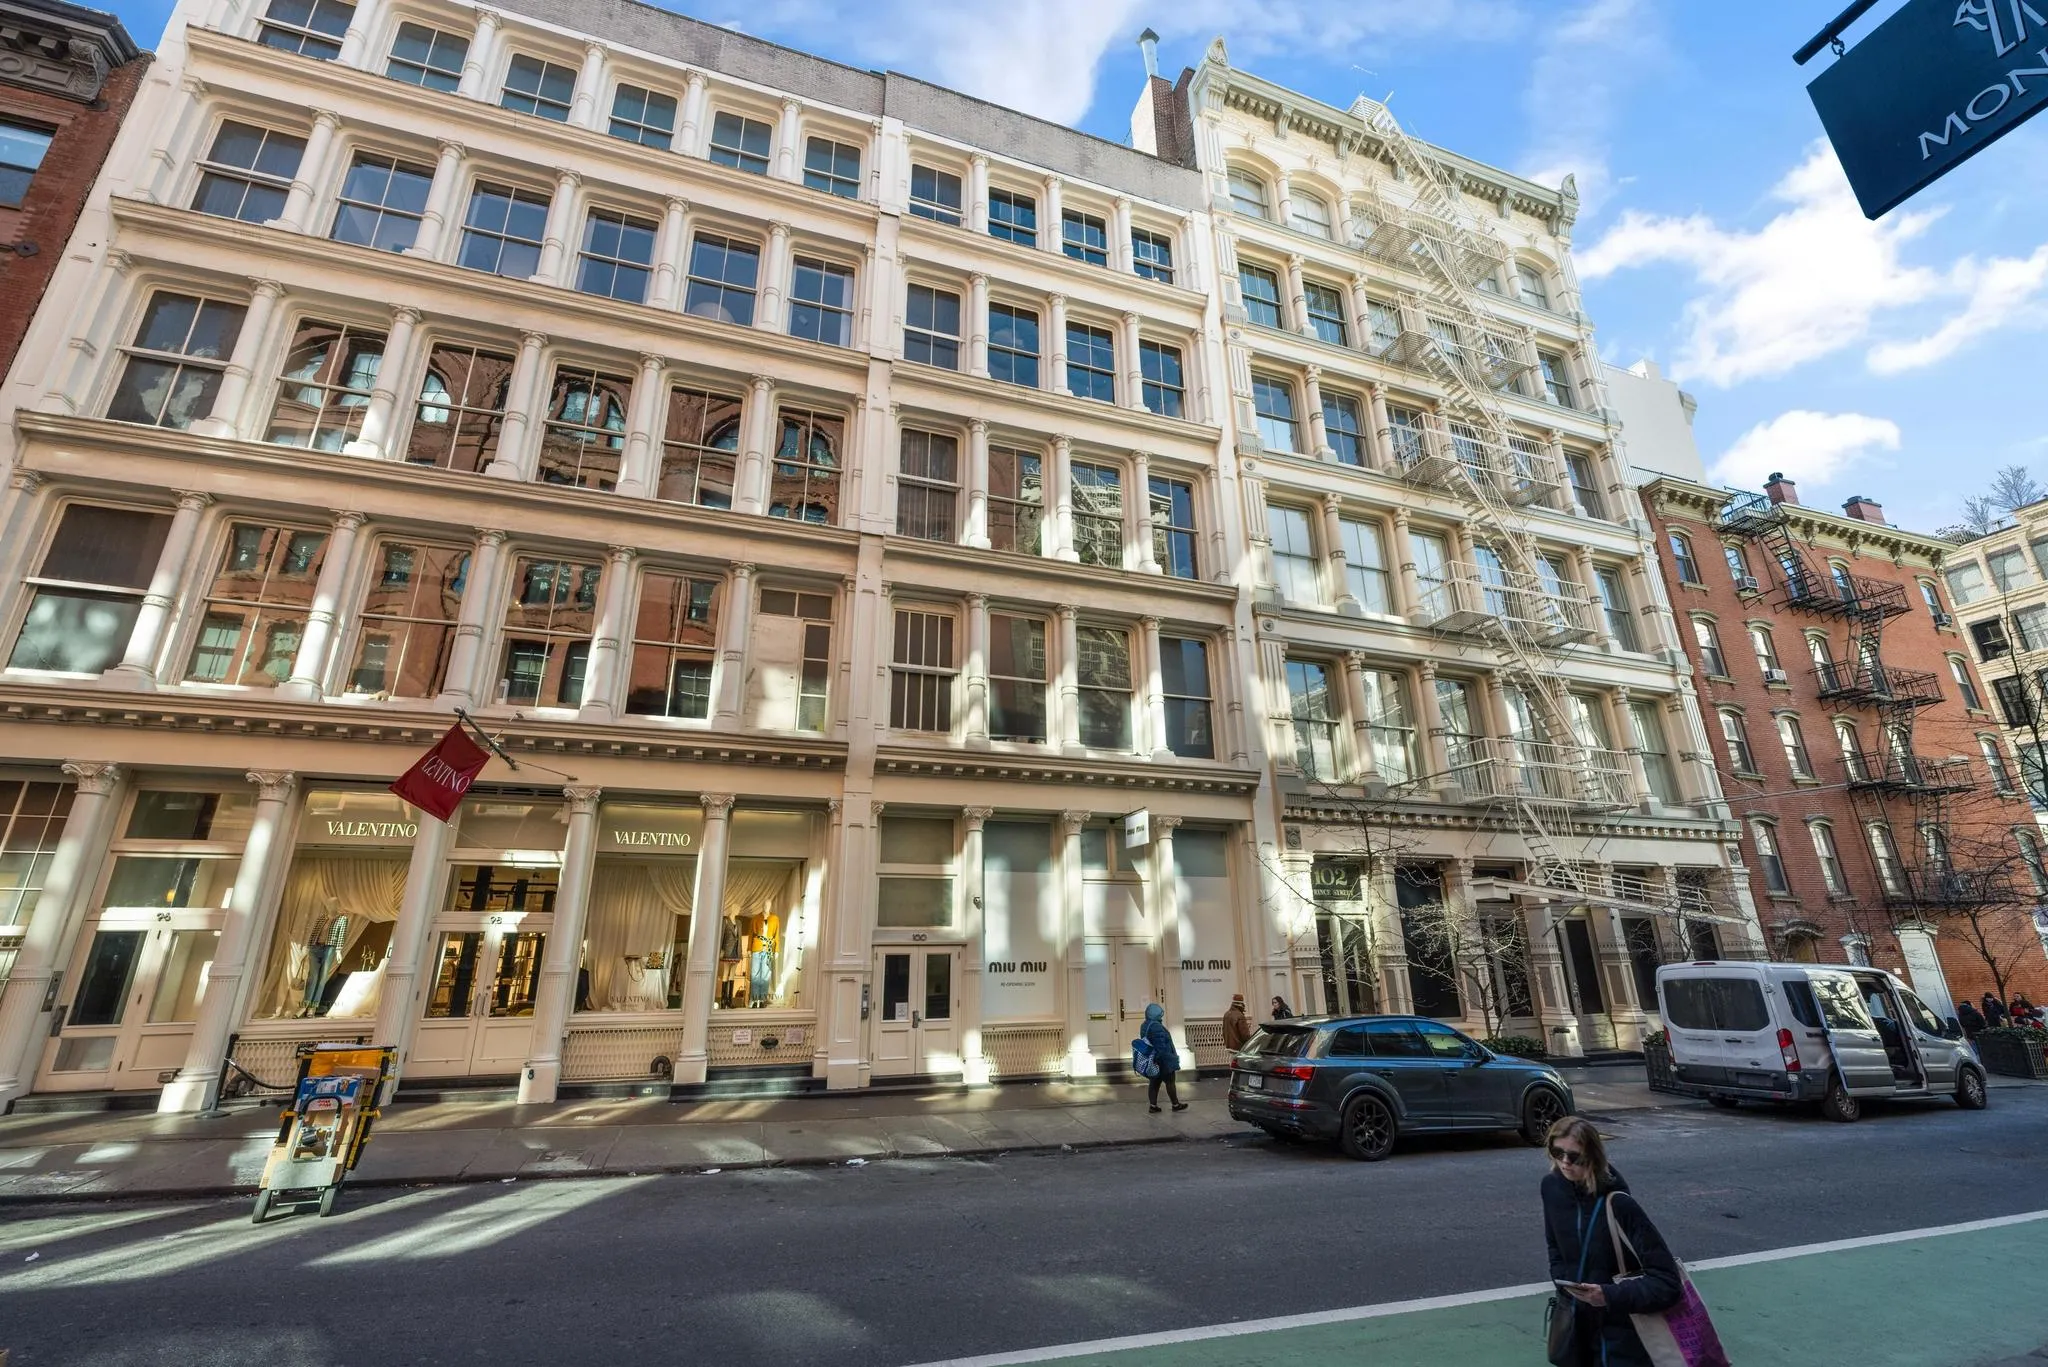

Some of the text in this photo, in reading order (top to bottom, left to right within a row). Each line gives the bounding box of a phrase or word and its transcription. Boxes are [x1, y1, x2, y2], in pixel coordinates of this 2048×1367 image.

[327, 821, 418, 838] VALENTINO
[614, 831, 691, 846] VALENTINO
[1314, 867, 1347, 886] 102
